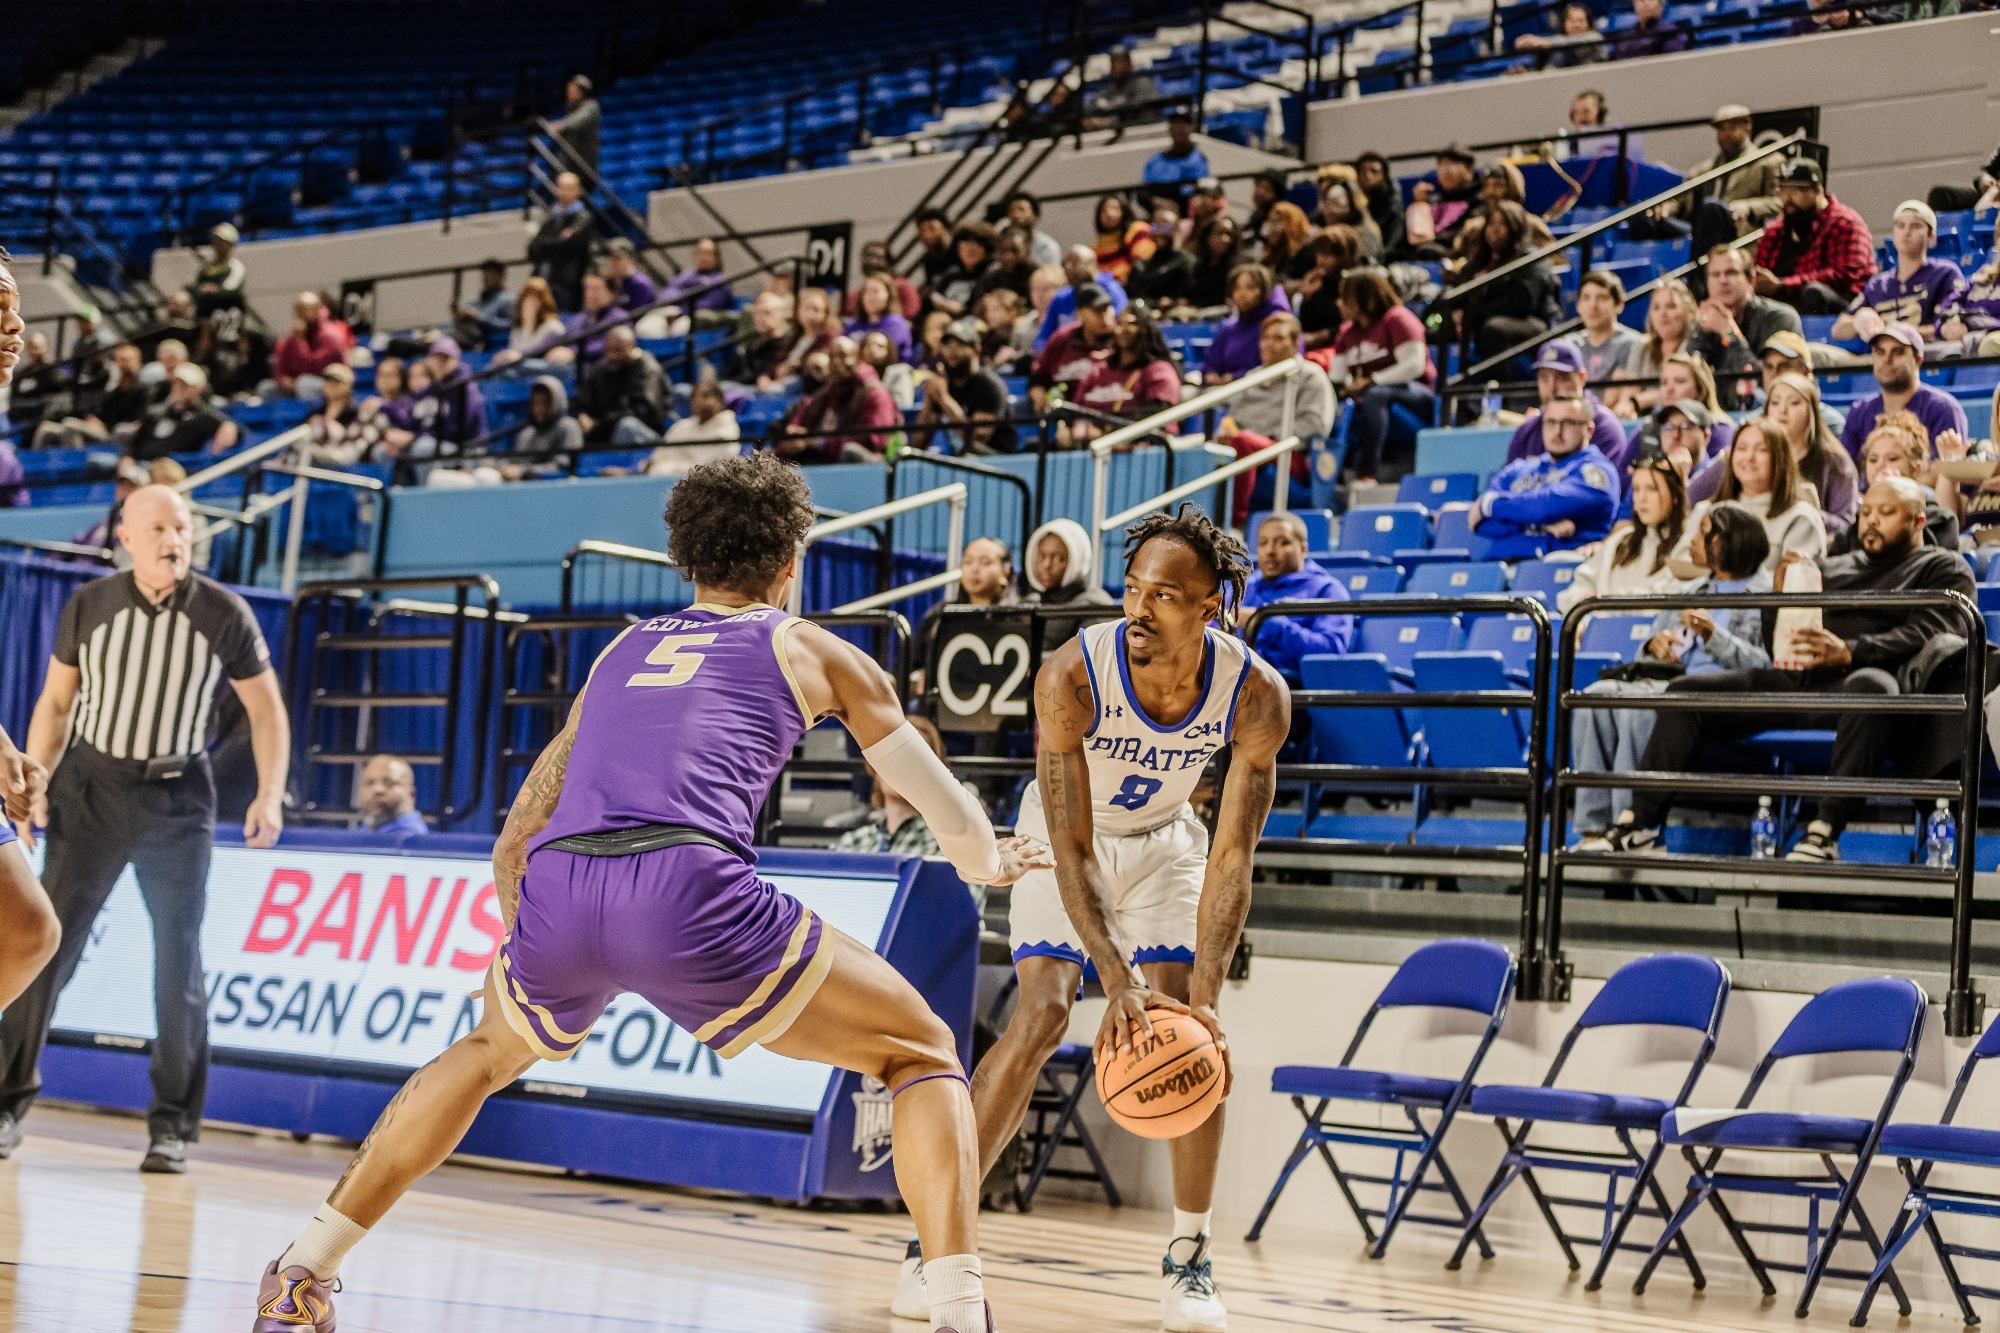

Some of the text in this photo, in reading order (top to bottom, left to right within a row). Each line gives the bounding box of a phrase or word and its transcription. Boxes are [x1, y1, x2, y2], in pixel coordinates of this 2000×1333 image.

[641, 609, 776, 632] EDWDS
[625, 632, 720, 688] 5
[937, 632, 1031, 716] C2
[1183, 720, 1222, 739] CAA
[1088, 737, 1218, 772] PIRATES
[1109, 774, 1164, 811] 8
[203, 972, 357, 1036] ISSAN
[365, 988, 447, 1043] OF
[1134, 1055, 1216, 1104] Wilson
